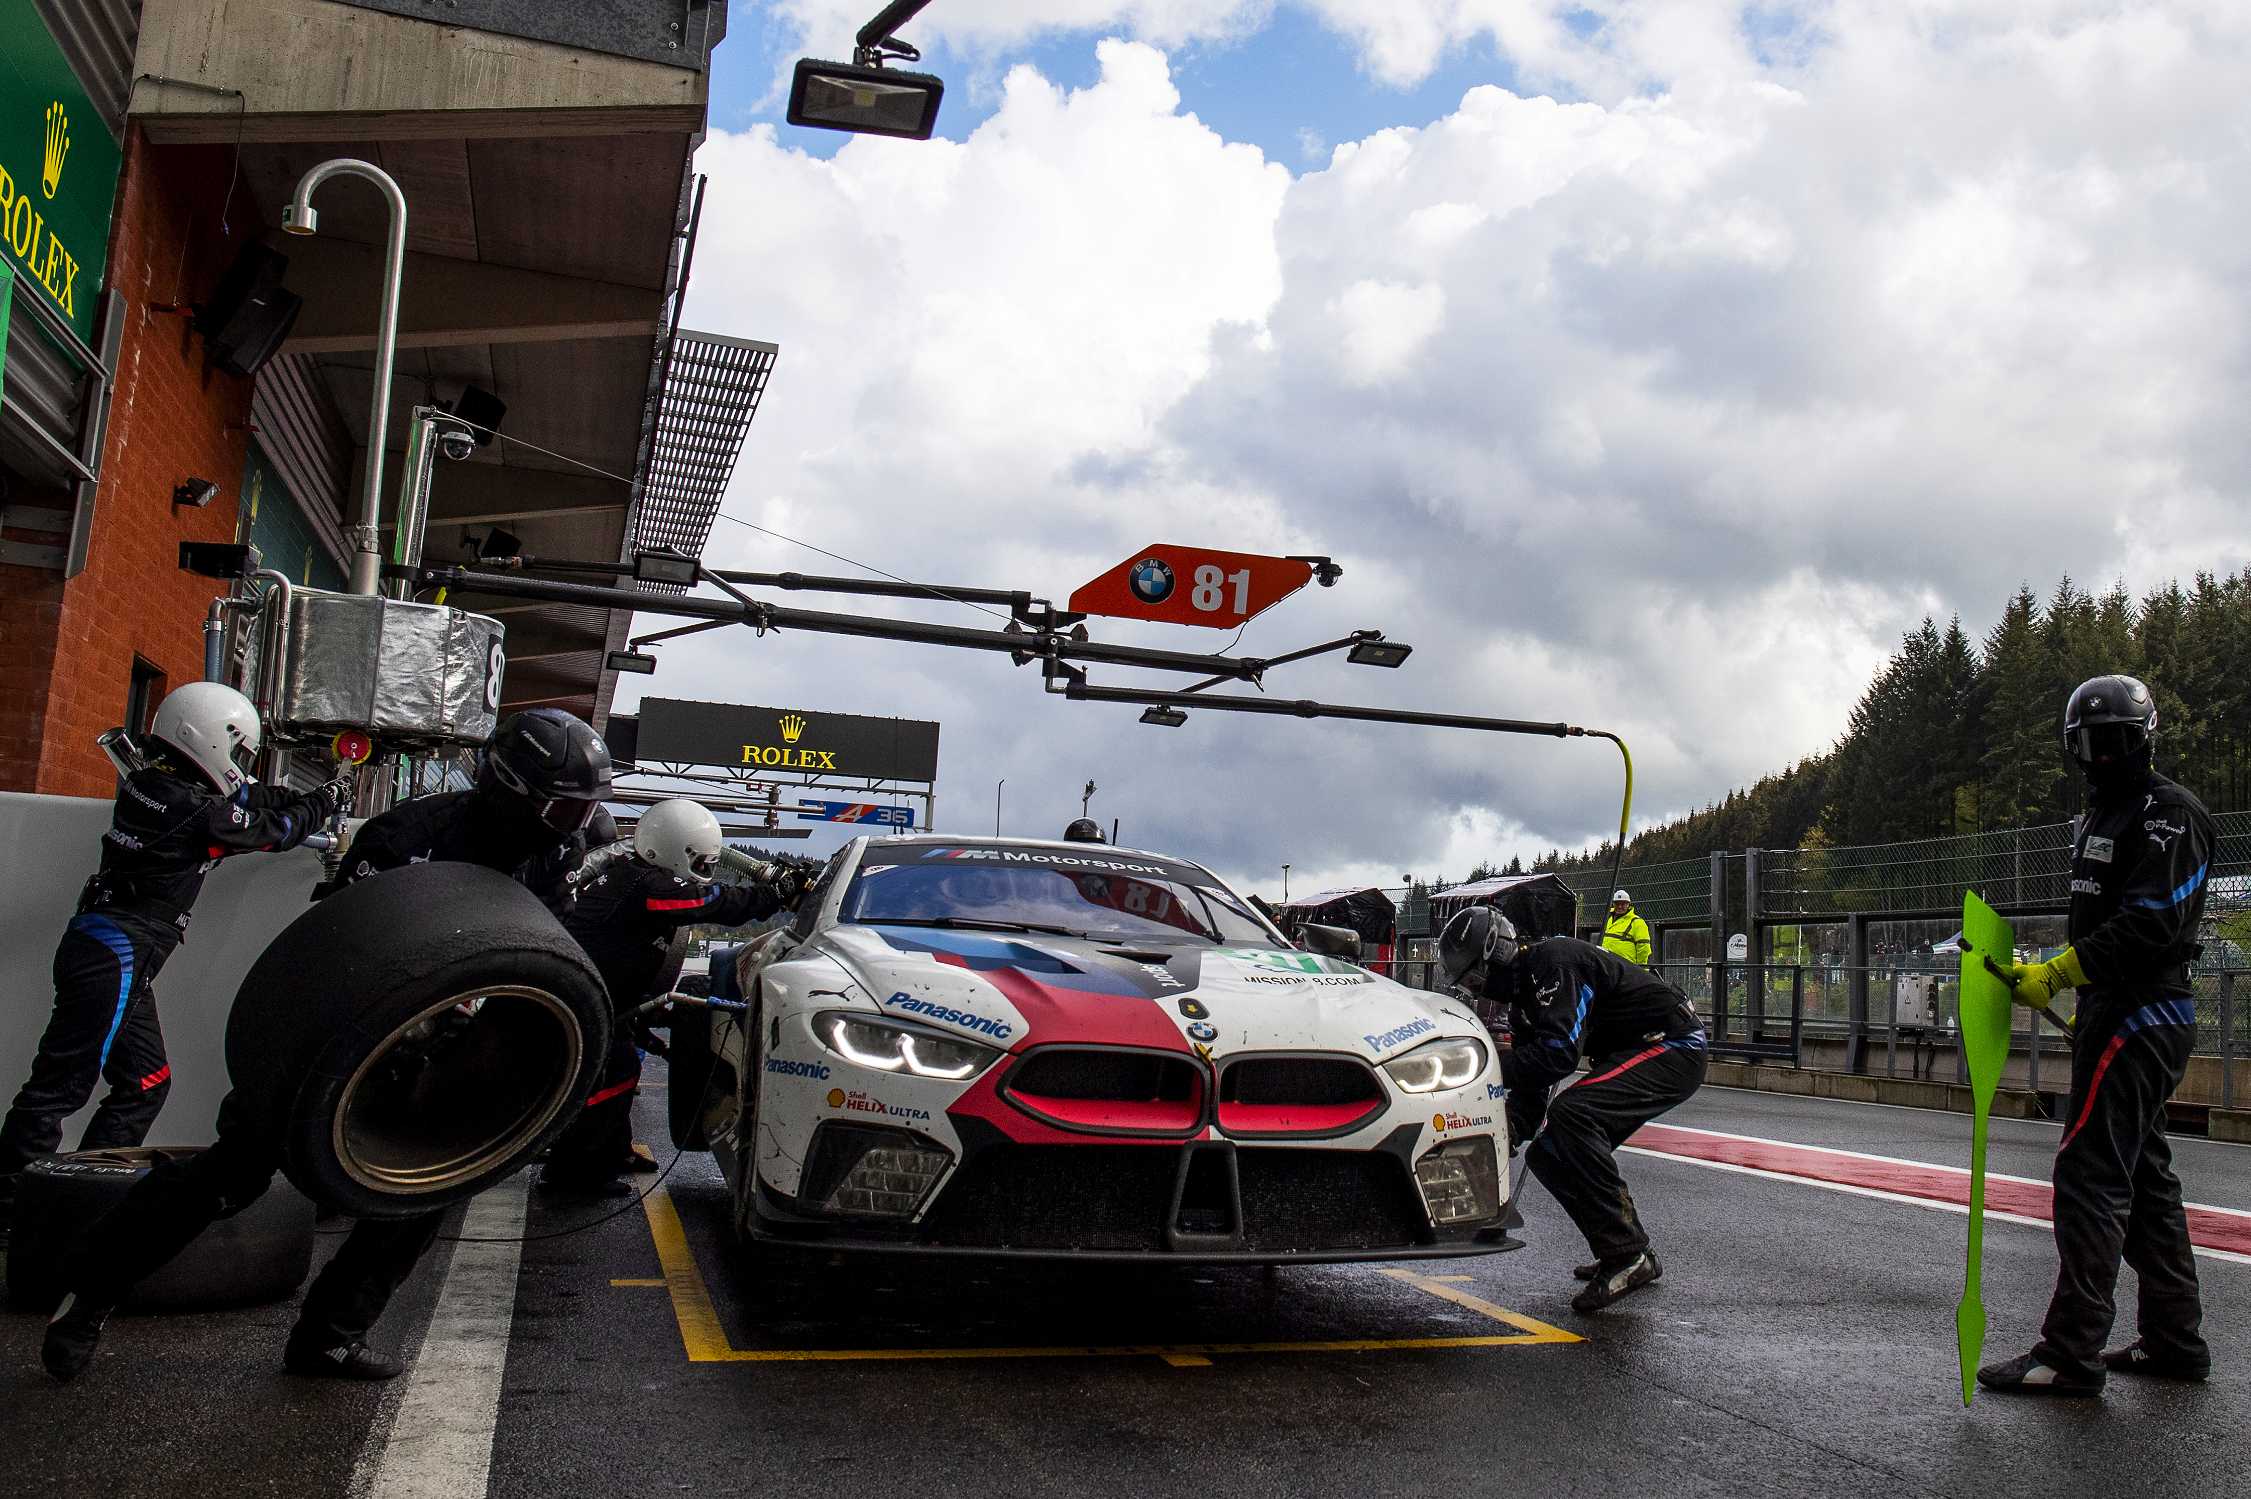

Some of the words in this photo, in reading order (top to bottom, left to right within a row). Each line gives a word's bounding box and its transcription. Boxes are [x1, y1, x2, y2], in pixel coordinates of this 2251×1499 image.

[0, 164, 80, 319] ROLEX
[1135, 559, 1172, 577] BMW
[1192, 564, 1250, 615] 81
[742, 745, 837, 770] ROLEX
[876, 808, 908, 824] 36
[111, 829, 144, 850] sonic
[1003, 851, 1168, 876] Motorsport
[2071, 876, 2102, 896] sonic
[885, 992, 1012, 1040] Panasonic
[1363, 1016, 1437, 1053] Panasonic
[847, 1090, 867, 1100] Shell
[847, 1098, 889, 1113] HELIX
[889, 1106, 930, 1120] ULTRA
[1446, 1117, 1472, 1130] HELIX
[1472, 1115, 1492, 1127] ULTRA
